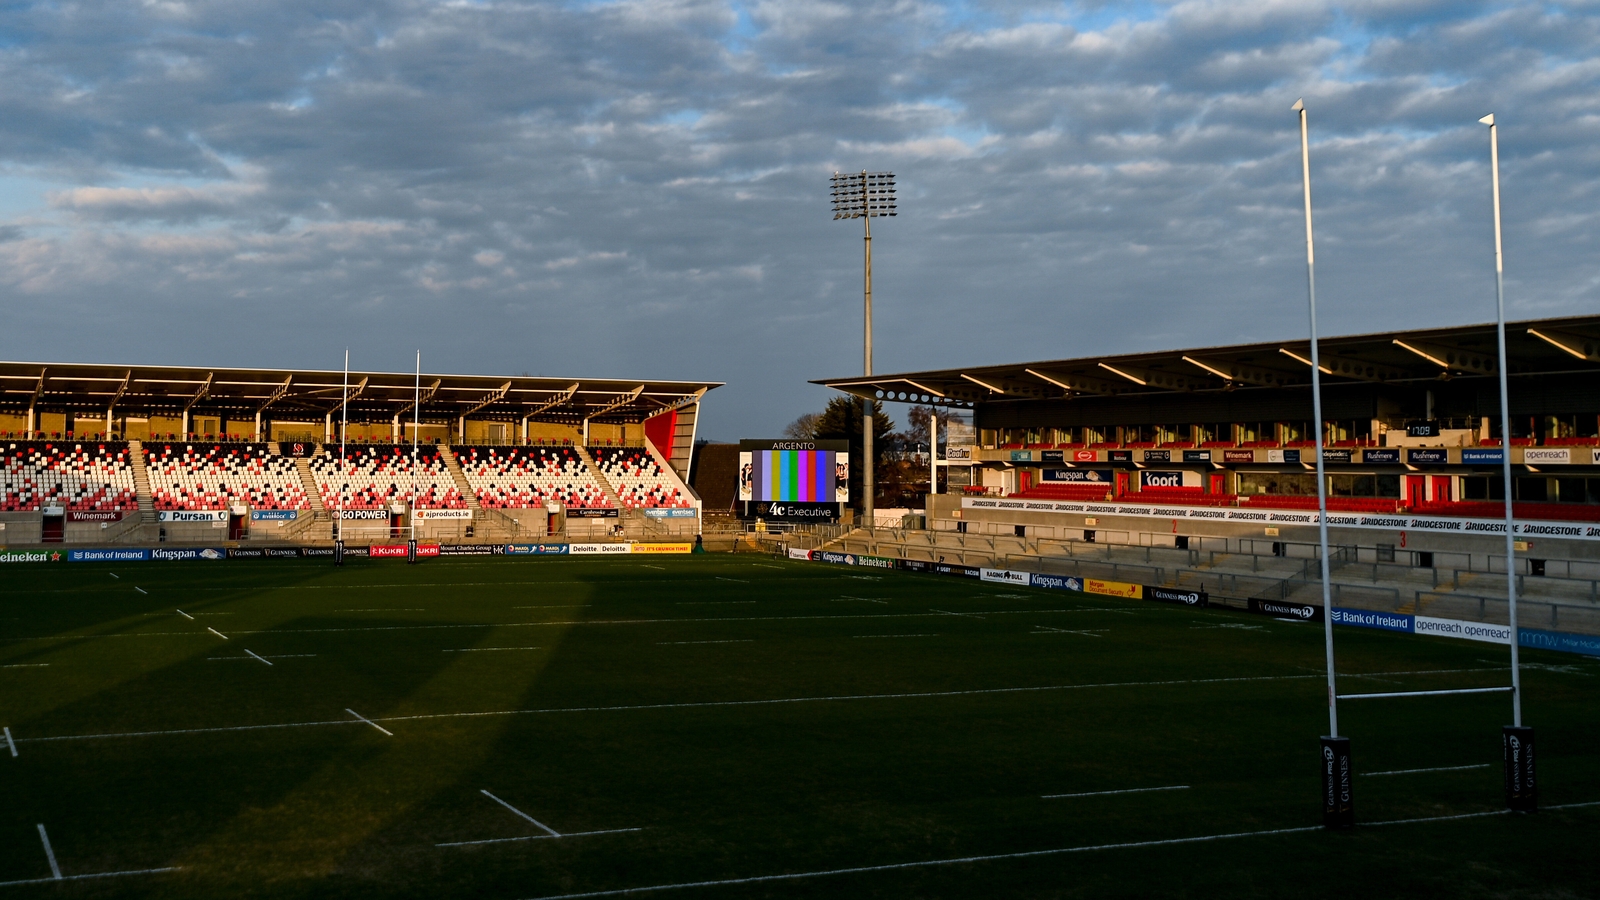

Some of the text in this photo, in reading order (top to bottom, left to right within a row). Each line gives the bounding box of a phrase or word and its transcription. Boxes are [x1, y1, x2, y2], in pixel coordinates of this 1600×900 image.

[772, 442, 815, 450] ARGENTO
[1526, 450, 1568, 459] openreach
[1055, 470, 1084, 480] Kingspan
[769, 502, 831, 516] 4c Executive
[1086, 505, 1116, 513] BRIDGESTONE
[1118, 506, 1150, 515] BRIDGESTONE
[1153, 508, 1187, 516] BRIDGESTONE
[1190, 510, 1225, 518] BRIDGESTONE
[172, 512, 213, 520] Pursan
[1228, 511, 1267, 520] BRIDGESTONE
[1270, 513, 1310, 522] BRIDGESTONE
[1314, 515, 1357, 524] BDGESTONE
[1172, 519, 1177, 533] 2
[1361, 517, 1407, 527] BRIDGESTONE
[1411, 519, 1461, 530] BRIDGESTONE
[1465, 522, 1519, 532] BRIDGESTOE
[1523, 524, 1582, 536] BRIDGESTONE
[1400, 531, 1406, 548] 3
[0, 552, 47, 562] eineken
[152, 549, 195, 560] Kingspan
[822, 551, 843, 563] Kingspan
[859, 556, 887, 568] Heineken
[1032, 574, 1062, 588] Kingspan
[1109, 588, 1124, 596] Security
[1155, 590, 1177, 600] GUINNESS
[1264, 604, 1289, 614] GUINNESS
[1343, 612, 1407, 628] Bank of Ireland
[1416, 619, 1461, 634] openreach
[1465, 626, 1511, 639] openreach
[1340, 756, 1349, 802] GUINNESS
